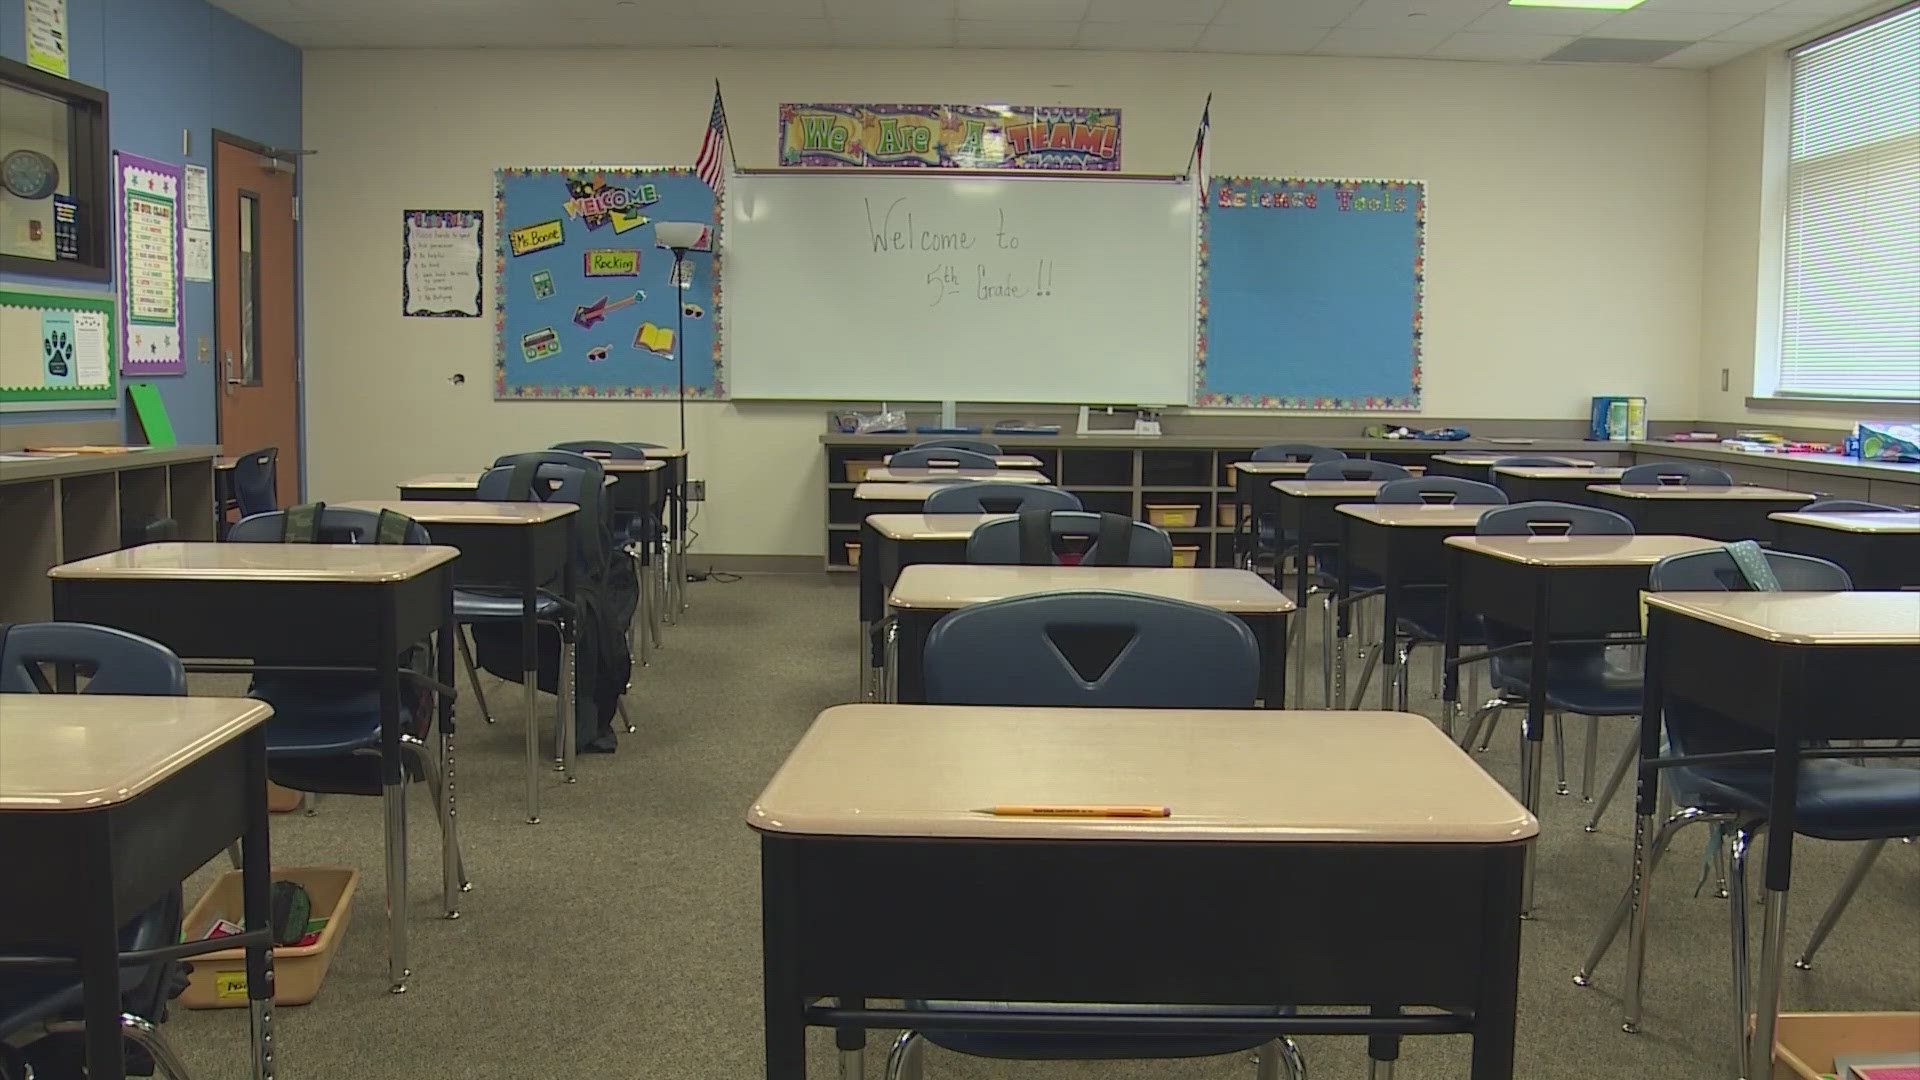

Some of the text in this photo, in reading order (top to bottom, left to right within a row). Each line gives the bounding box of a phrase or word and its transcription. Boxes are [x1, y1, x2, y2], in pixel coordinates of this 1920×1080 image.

[800, 114, 1118, 159] We Are A TEAM!
[563, 184, 656, 218] WELCOME
[1218, 186, 1407, 212] Science Tools
[864, 196, 1019, 253] Welcome to
[595, 255, 633, 272] Rocking
[927, 264, 960, 307] 5th
